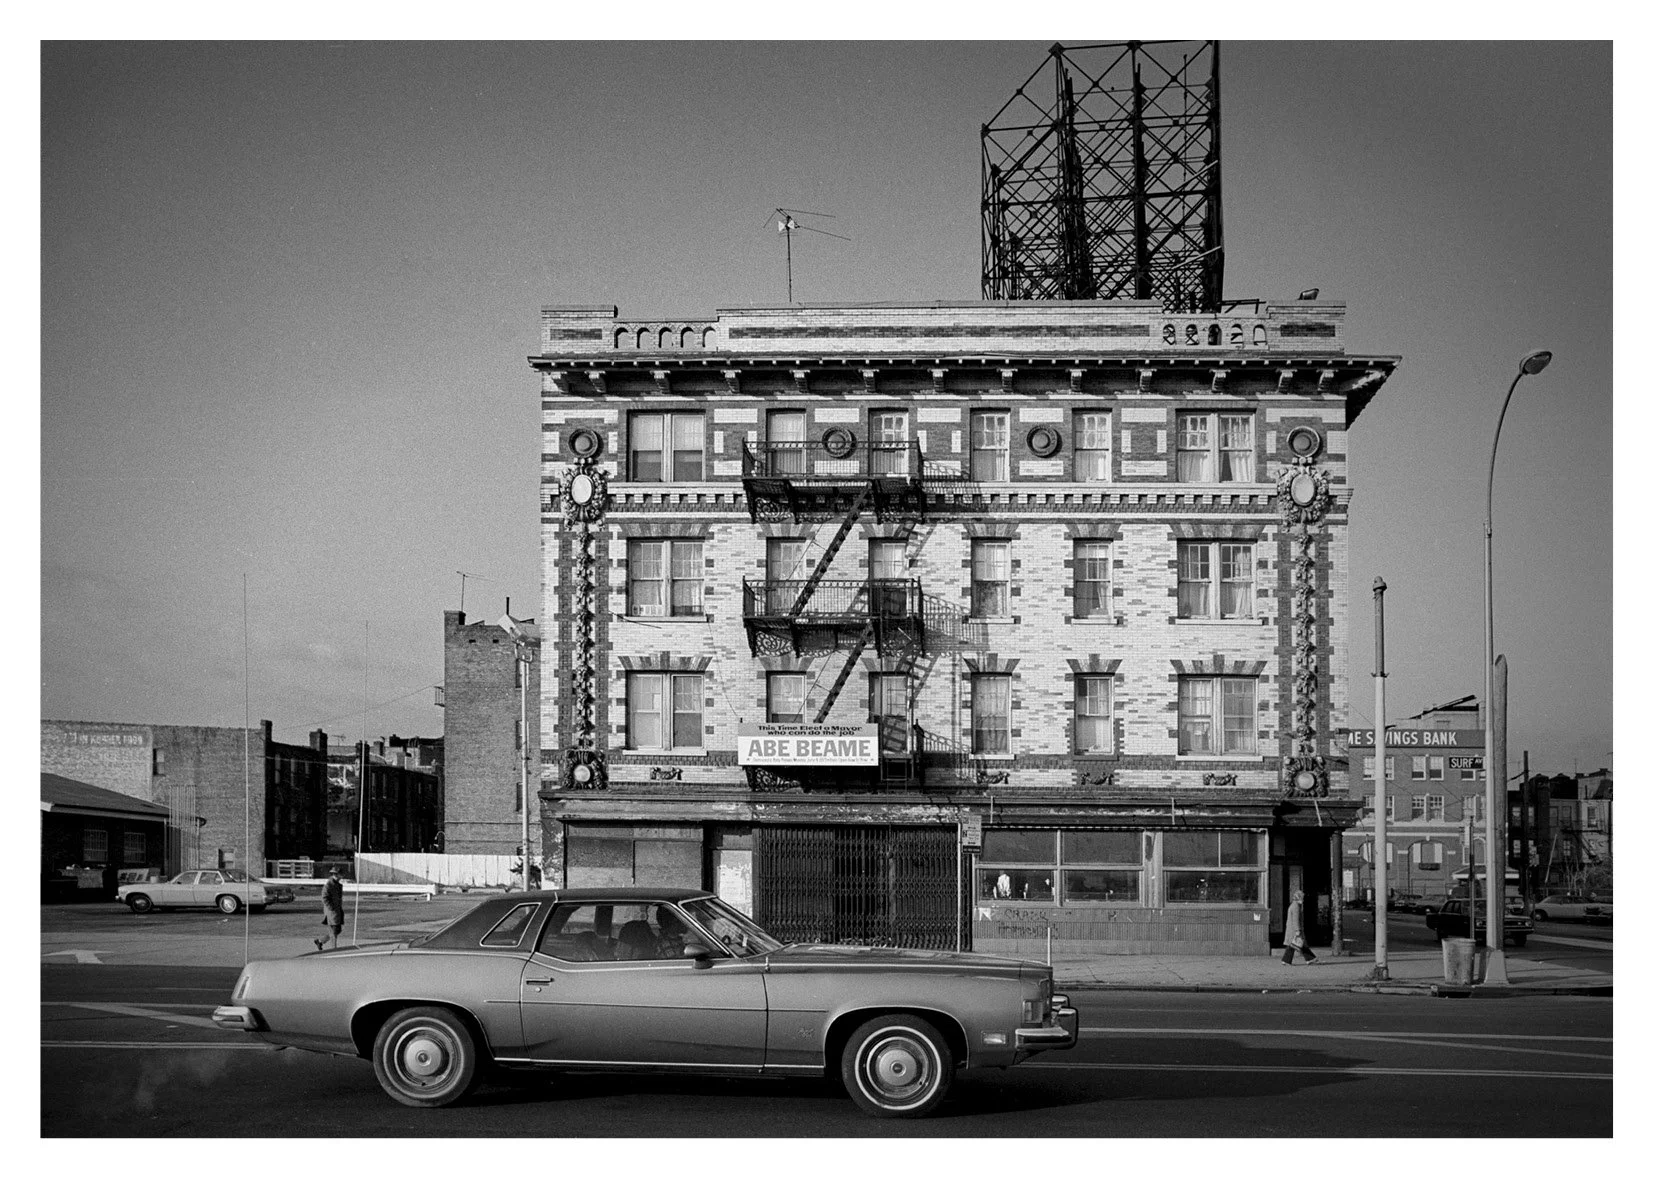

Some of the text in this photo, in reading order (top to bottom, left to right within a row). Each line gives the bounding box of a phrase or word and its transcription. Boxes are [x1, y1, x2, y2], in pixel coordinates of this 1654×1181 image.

[1423, 731, 1457, 745] BANK
[748, 740, 871, 757] ABE BEAME
[1451, 757, 1474, 768] SURF
